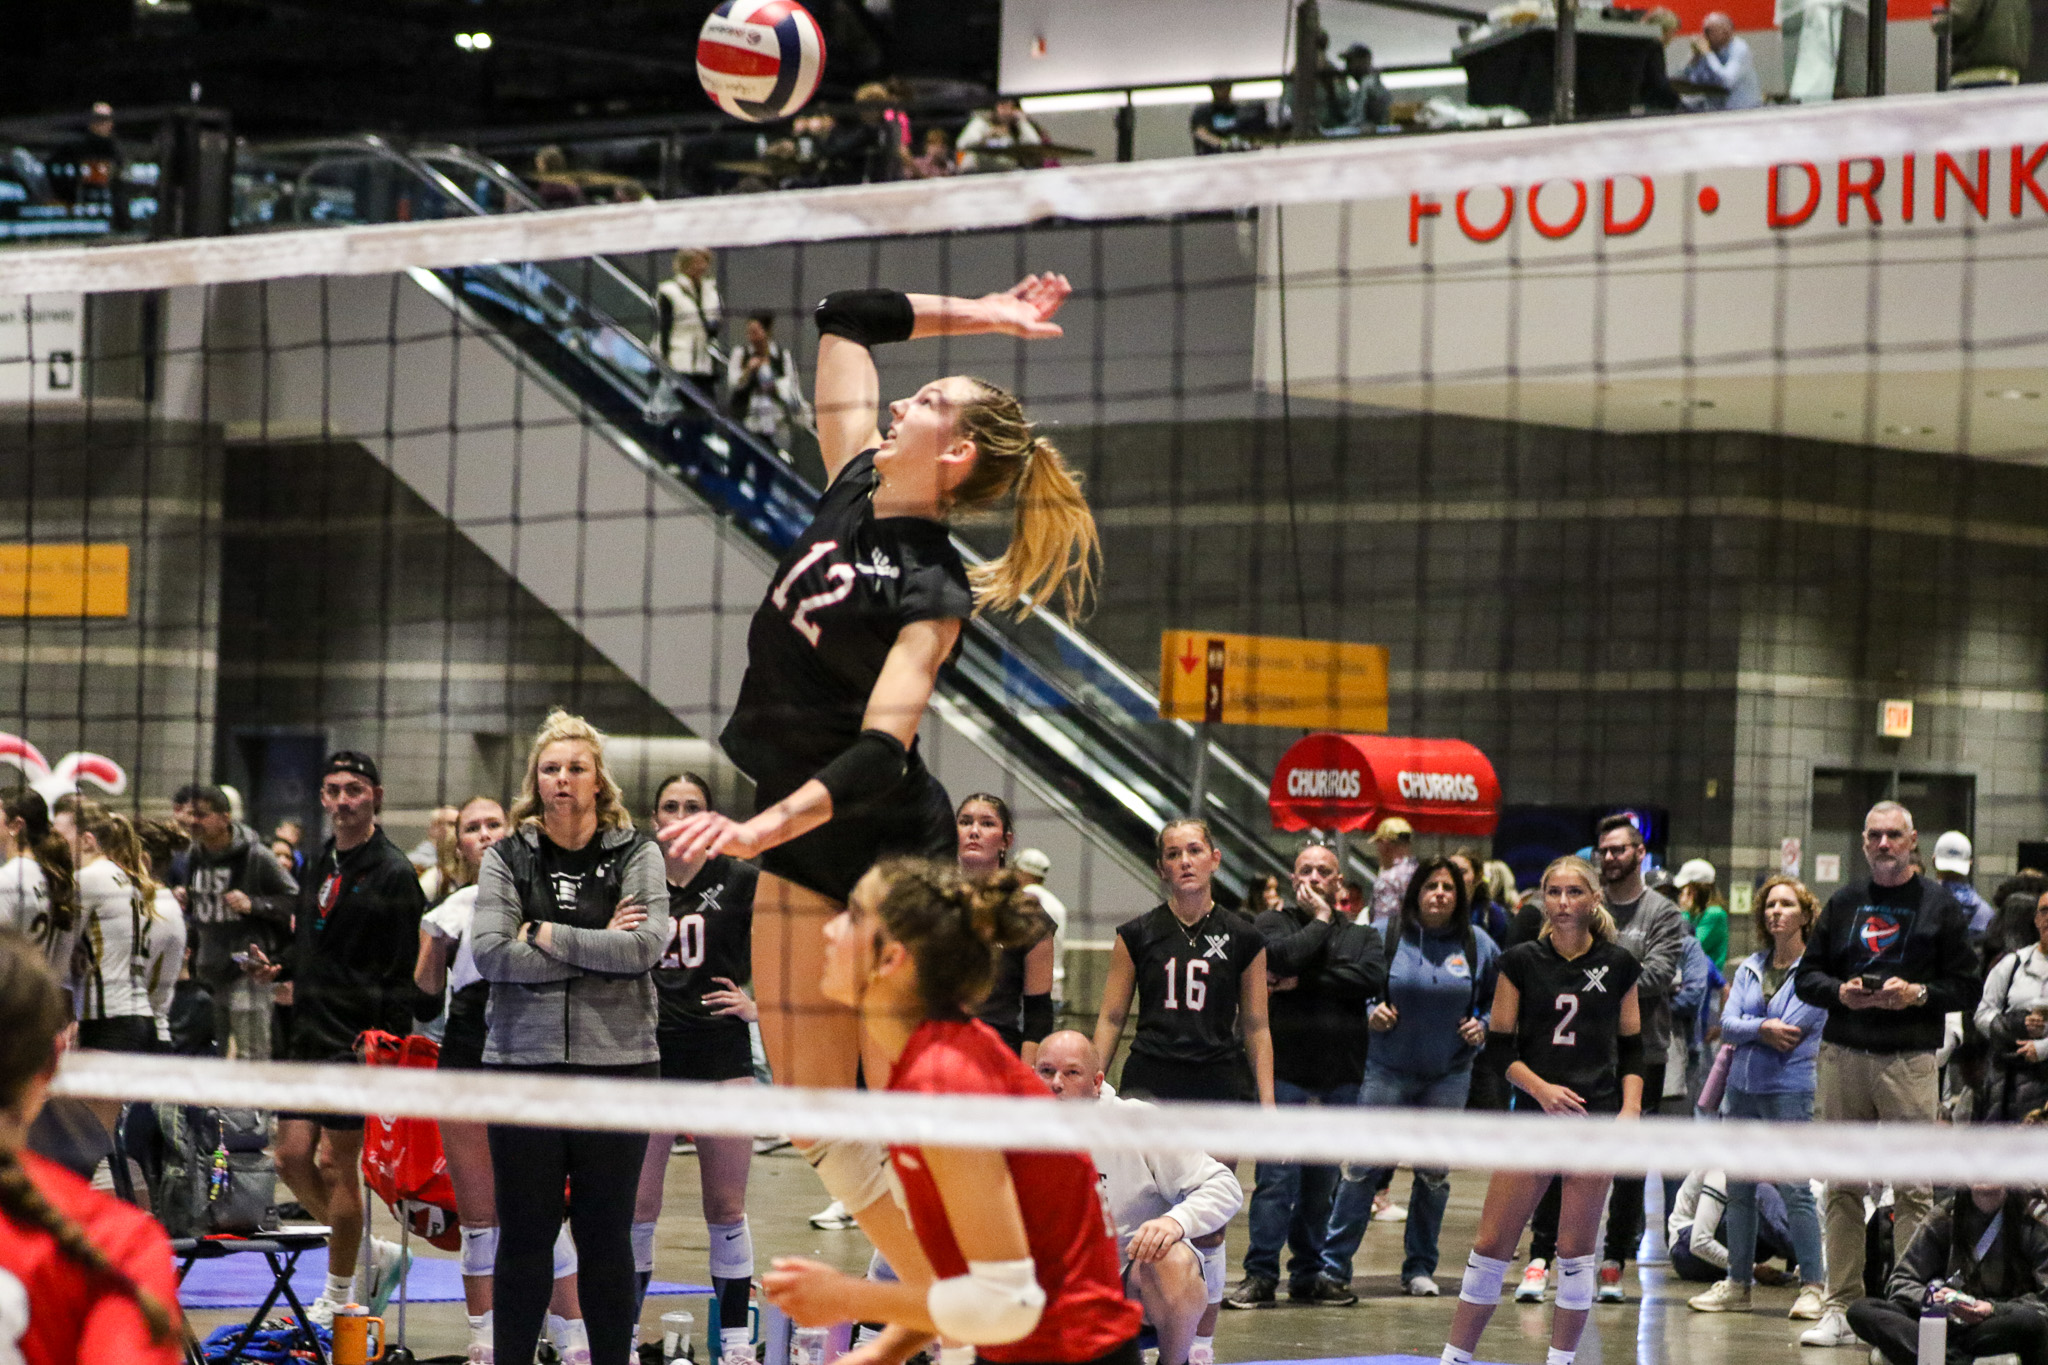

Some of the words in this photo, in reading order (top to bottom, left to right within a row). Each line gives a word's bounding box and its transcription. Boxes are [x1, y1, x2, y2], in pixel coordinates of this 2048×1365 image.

[1409, 175, 1655, 243] FOOD
[1767, 141, 2048, 228] DRINK
[772, 540, 856, 647] 12
[1287, 767, 1361, 798] CHURROS
[1397, 770, 1479, 802] CHURROS
[660, 913, 705, 968] 20
[1164, 957, 1210, 1011] 16
[1552, 993, 1579, 1045] 2
